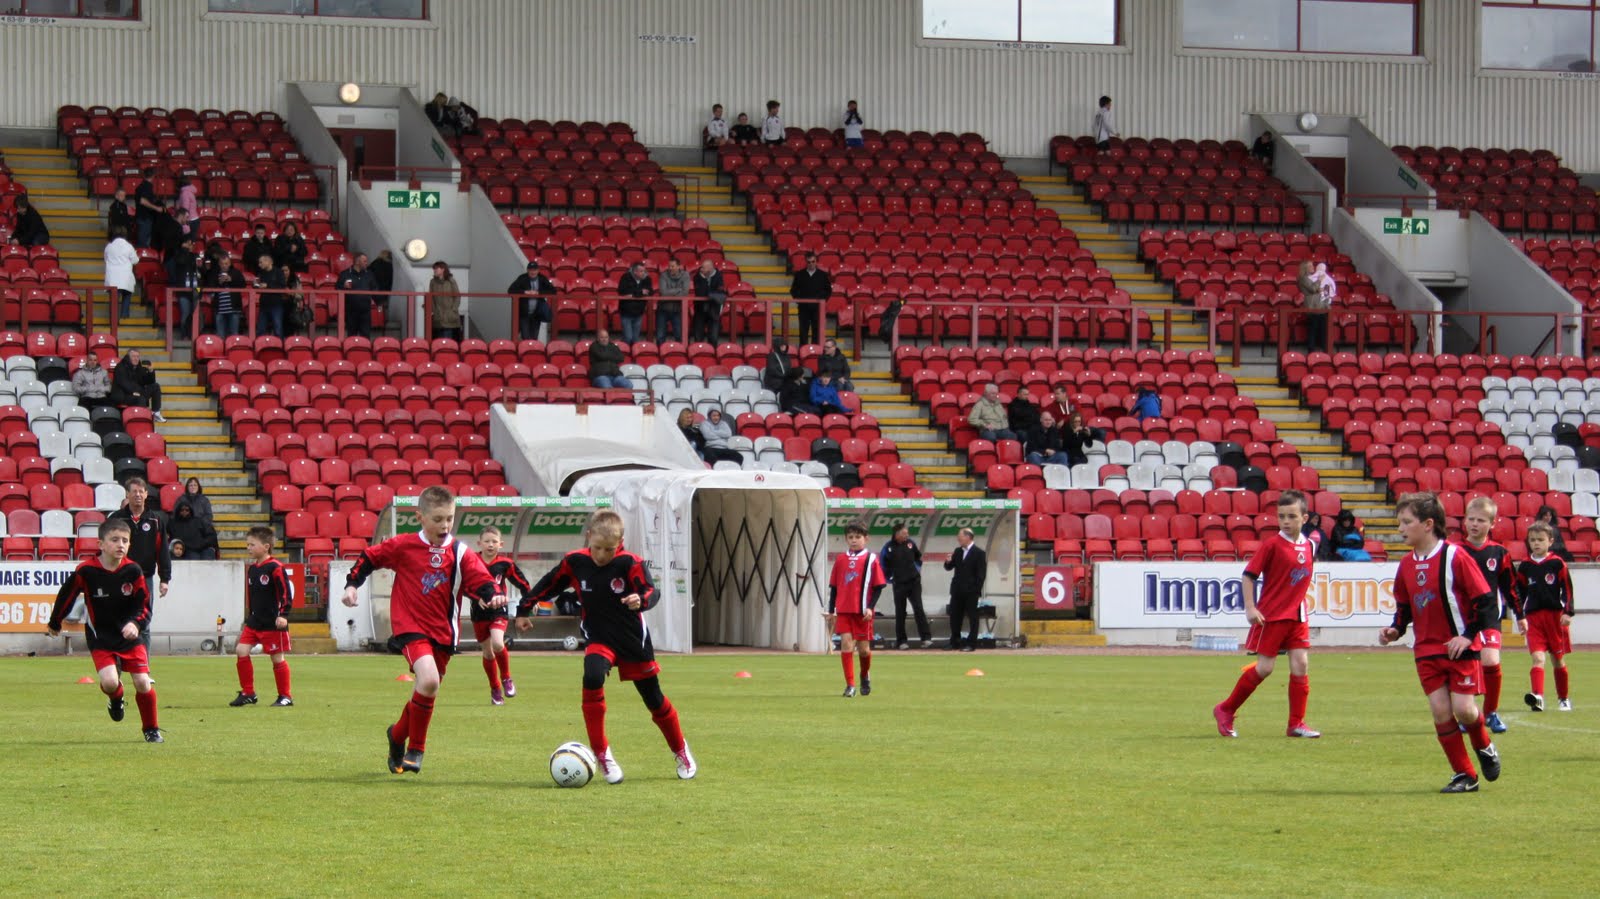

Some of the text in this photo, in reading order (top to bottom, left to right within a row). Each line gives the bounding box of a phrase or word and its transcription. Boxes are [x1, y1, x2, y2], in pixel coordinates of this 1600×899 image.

[389, 195, 404, 203] Exit
[1385, 222, 1398, 230] Exit
[396, 513, 420, 527] bo
[463, 513, 517, 527] bott
[534, 513, 586, 527] bott
[874, 515, 926, 528] bott
[941, 515, 992, 528] bott
[0, 570, 30, 586] AGE
[1041, 571, 1065, 604] 6
[28, 602, 54, 624] 79
